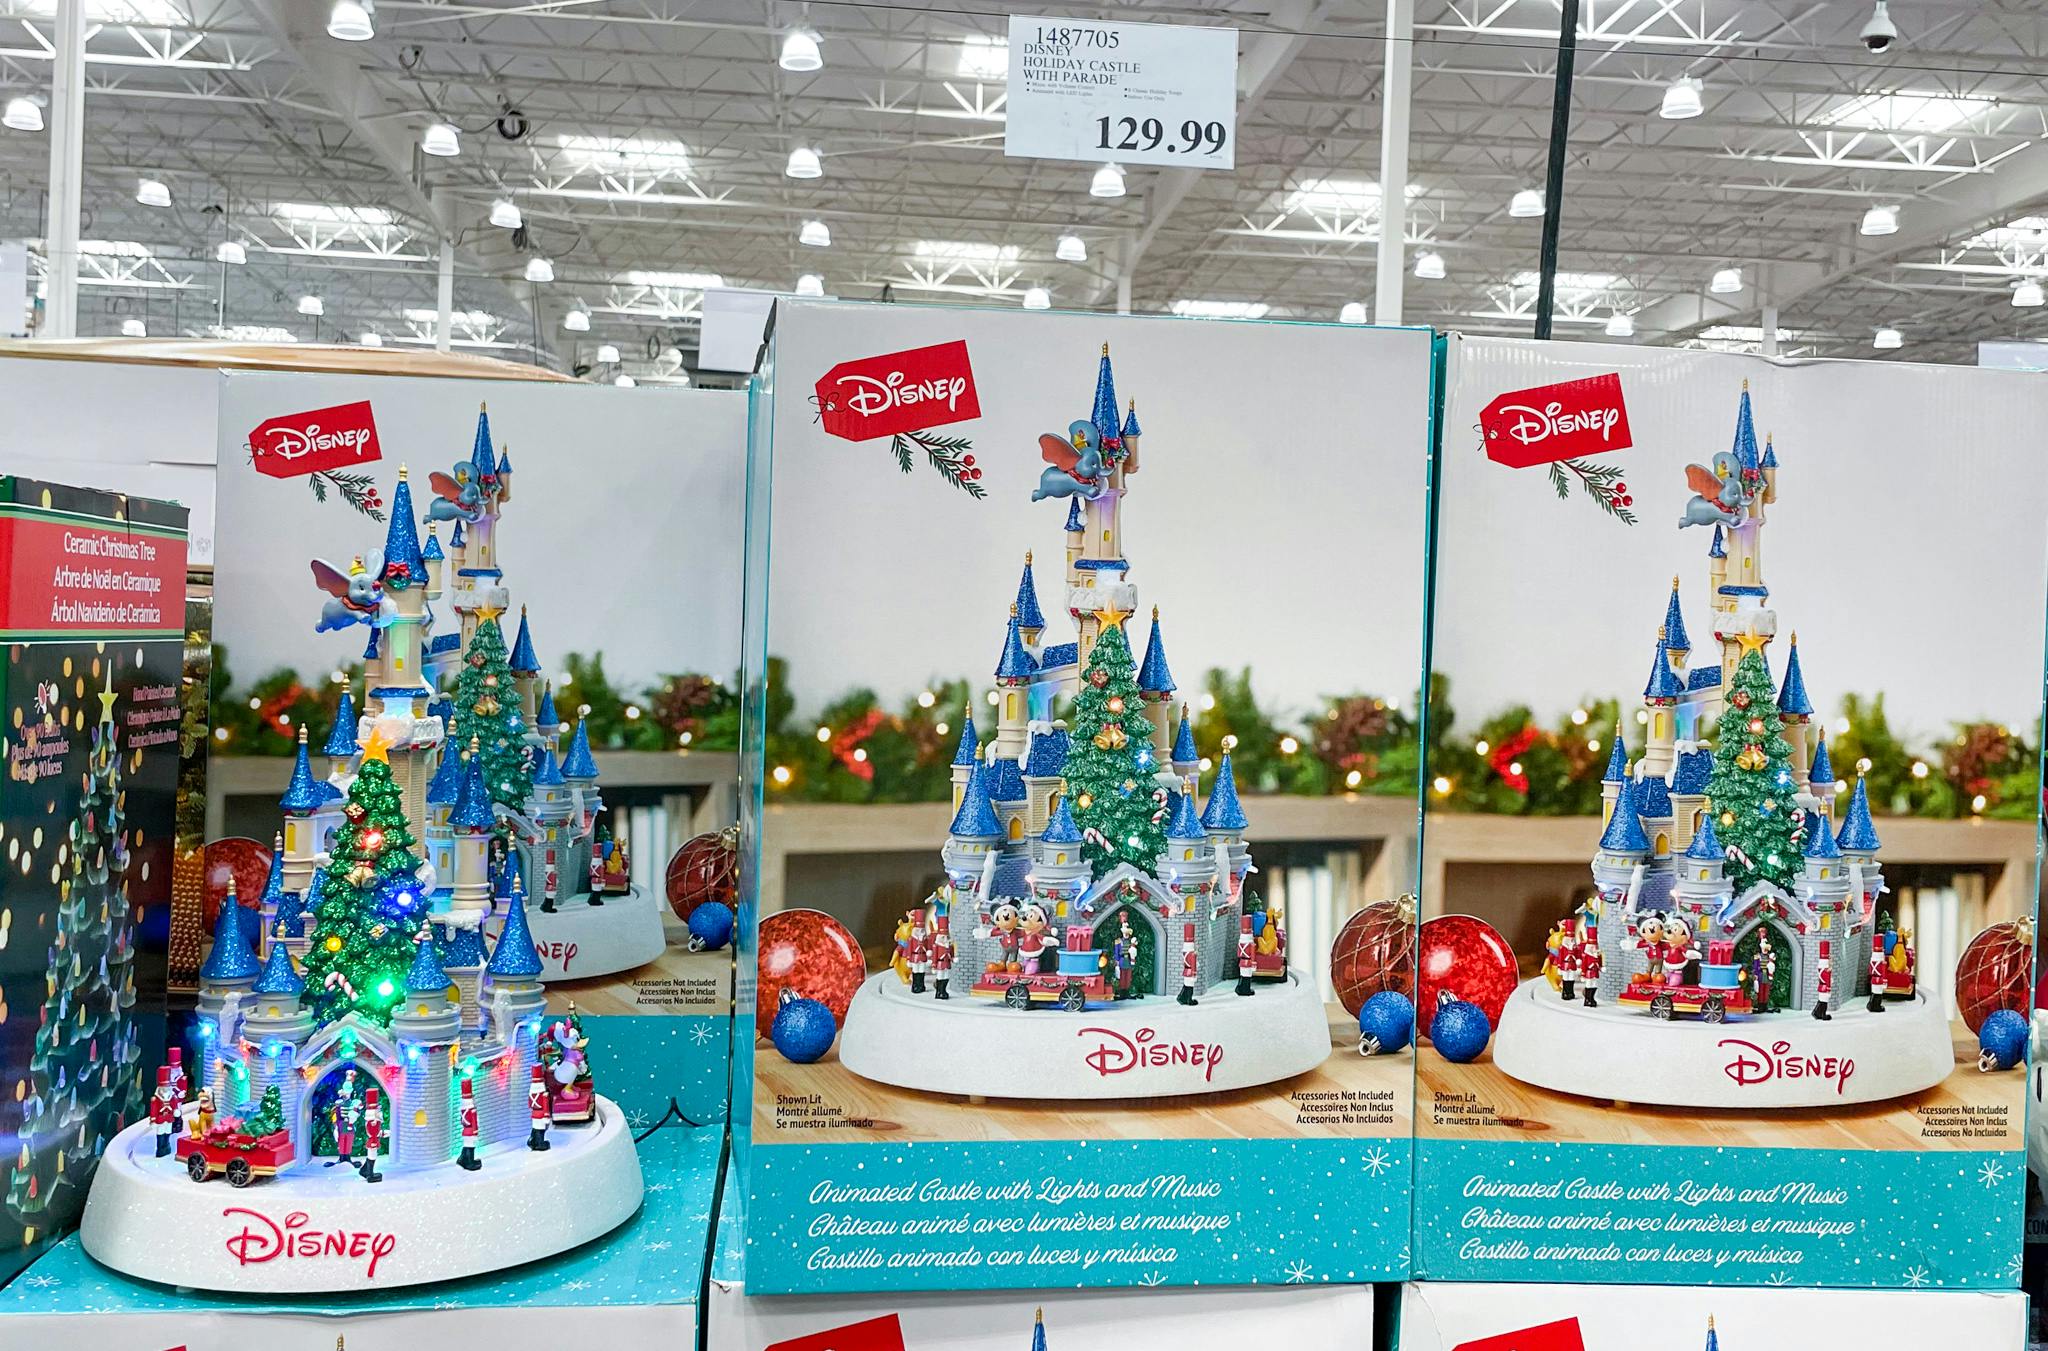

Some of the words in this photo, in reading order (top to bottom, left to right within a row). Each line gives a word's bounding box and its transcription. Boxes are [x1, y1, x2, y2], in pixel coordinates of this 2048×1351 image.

[1037, 27, 1120, 48] 1487705
[1024, 43, 1073, 56] DISNEY
[1023, 56, 1085, 70] HOLIDAY
[1089, 60, 1141, 73] CASTLE
[1023, 69, 1058, 81] WITH
[1063, 72, 1117, 85] PARADE
[1096, 116, 1226, 155] 129.99
[837, 371, 966, 417] Disney
[1499, 401, 1619, 446] Disney
[265, 424, 370, 460] Disney
[64, 531, 99, 556] Ceramic
[100, 535, 138, 560] Christmas
[140, 541, 156, 561] Tree
[53, 564, 80, 588] Arbre
[81, 566, 92, 589] de
[93, 568, 111, 590] Noël
[112, 577, 121, 591] en
[122, 571, 161, 597] Céramique
[51, 595, 77, 622] Árbol
[78, 600, 116, 623] Navideño
[116, 601, 126, 623] de
[127, 603, 160, 623] Cerámica
[633, 979, 671, 987] Accessories
[673, 979, 685, 987] Not
[687, 978, 716, 987] Included
[640, 988, 679, 996] Accessoires
[680, 988, 694, 996] Non
[696, 987, 716, 996] Inclus
[674, 997, 683, 1005] No
[685, 997, 716, 1005] Incluidos
[1078, 1027, 1224, 1082] Disney
[1718, 1039, 1855, 1095] Disney
[777, 1094, 807, 1105] Shown
[810, 1094, 822, 1104] Lit
[1291, 1091, 1339, 1100] Accessories
[1341, 1091, 1356, 1100] Not
[1358, 1090, 1394, 1100] Included
[1434, 1091, 1462, 1102] Shown
[1465, 1092, 1476, 1102] Lit
[776, 1105, 809, 1117] Montré
[811, 1105, 842, 1116] allumé
[1300, 1102, 1348, 1112] Accessoires
[1350, 1102, 1367, 1112] Non
[1369, 1102, 1394, 1112] Inclus
[1434, 1103, 1464, 1114] Montré
[1466, 1104, 1495, 1114] allumé
[1917, 1105, 1960, 1115] Accessories
[1961, 1105, 1975, 1115] Not
[1976, 1105, 2008, 1115] Included
[776, 1119, 787, 1129] Se
[790, 1119, 826, 1128] muestra
[828, 1117, 873, 1128] iluminado
[1296, 1114, 1340, 1124] Accesorios
[1342, 1114, 1354, 1124] No
[1356, 1114, 1393, 1124] Incluidos
[1433, 1115, 1444, 1125] Se
[1446, 1116, 1480, 1126] muestra
[1482, 1117, 1524, 1127] iluminado
[1925, 1116, 1968, 1126] Accessoires
[1969, 1116, 1984, 1126] Non
[1986, 1116, 2007, 1126] Inclus
[1921, 1128, 1960, 1137] Accesorios
[1962, 1128, 1972, 1137] No
[1974, 1128, 2007, 1137] Incluidos
[808, 1179, 918, 1204] Animated
[918, 1177, 983, 1203] Castle
[985, 1179, 1033, 1201] with
[1035, 1176, 1102, 1205] Lights
[1105, 1177, 1150, 1199] and
[1151, 1174, 1222, 1200] Music
[1462, 1174, 1564, 1199] Animated
[1564, 1177, 1625, 1200] Castle
[1627, 1181, 1671, 1201] with
[1674, 1179, 1736, 1207] Lights
[1738, 1184, 1781, 1203] and
[1782, 1181, 1849, 1205] Music
[808, 1213, 899, 1237] Château
[901, 1213, 971, 1235] animé
[973, 1218, 1025, 1233] avec
[1027, 1211, 1117, 1233] lumières
[1120, 1213, 1141, 1231] et
[1141, 1211, 1231, 1235] musique
[1461, 1206, 1545, 1229] Château
[1547, 1210, 1613, 1231] animé
[1614, 1216, 1662, 1231] avec
[1664, 1212, 1749, 1233] lumières
[1751, 1214, 1770, 1233] et
[1770, 1216, 1856, 1239] musique
[223, 1207, 396, 1278] Disney
[807, 1246, 885, 1270] Castillo
[887, 1245, 984, 1267] animado
[986, 1250, 1025, 1266] con
[1027, 1244, 1081, 1265] luces
[1083, 1249, 1099, 1270] y
[1101, 1241, 1179, 1264] música
[1459, 1237, 1531, 1260] Castillo
[1533, 1241, 1623, 1261] animado
[1625, 1248, 1661, 1262] con
[1663, 1243, 1714, 1263] luces
[1716, 1250, 1731, 1269] y
[1732, 1244, 1804, 1264] música
